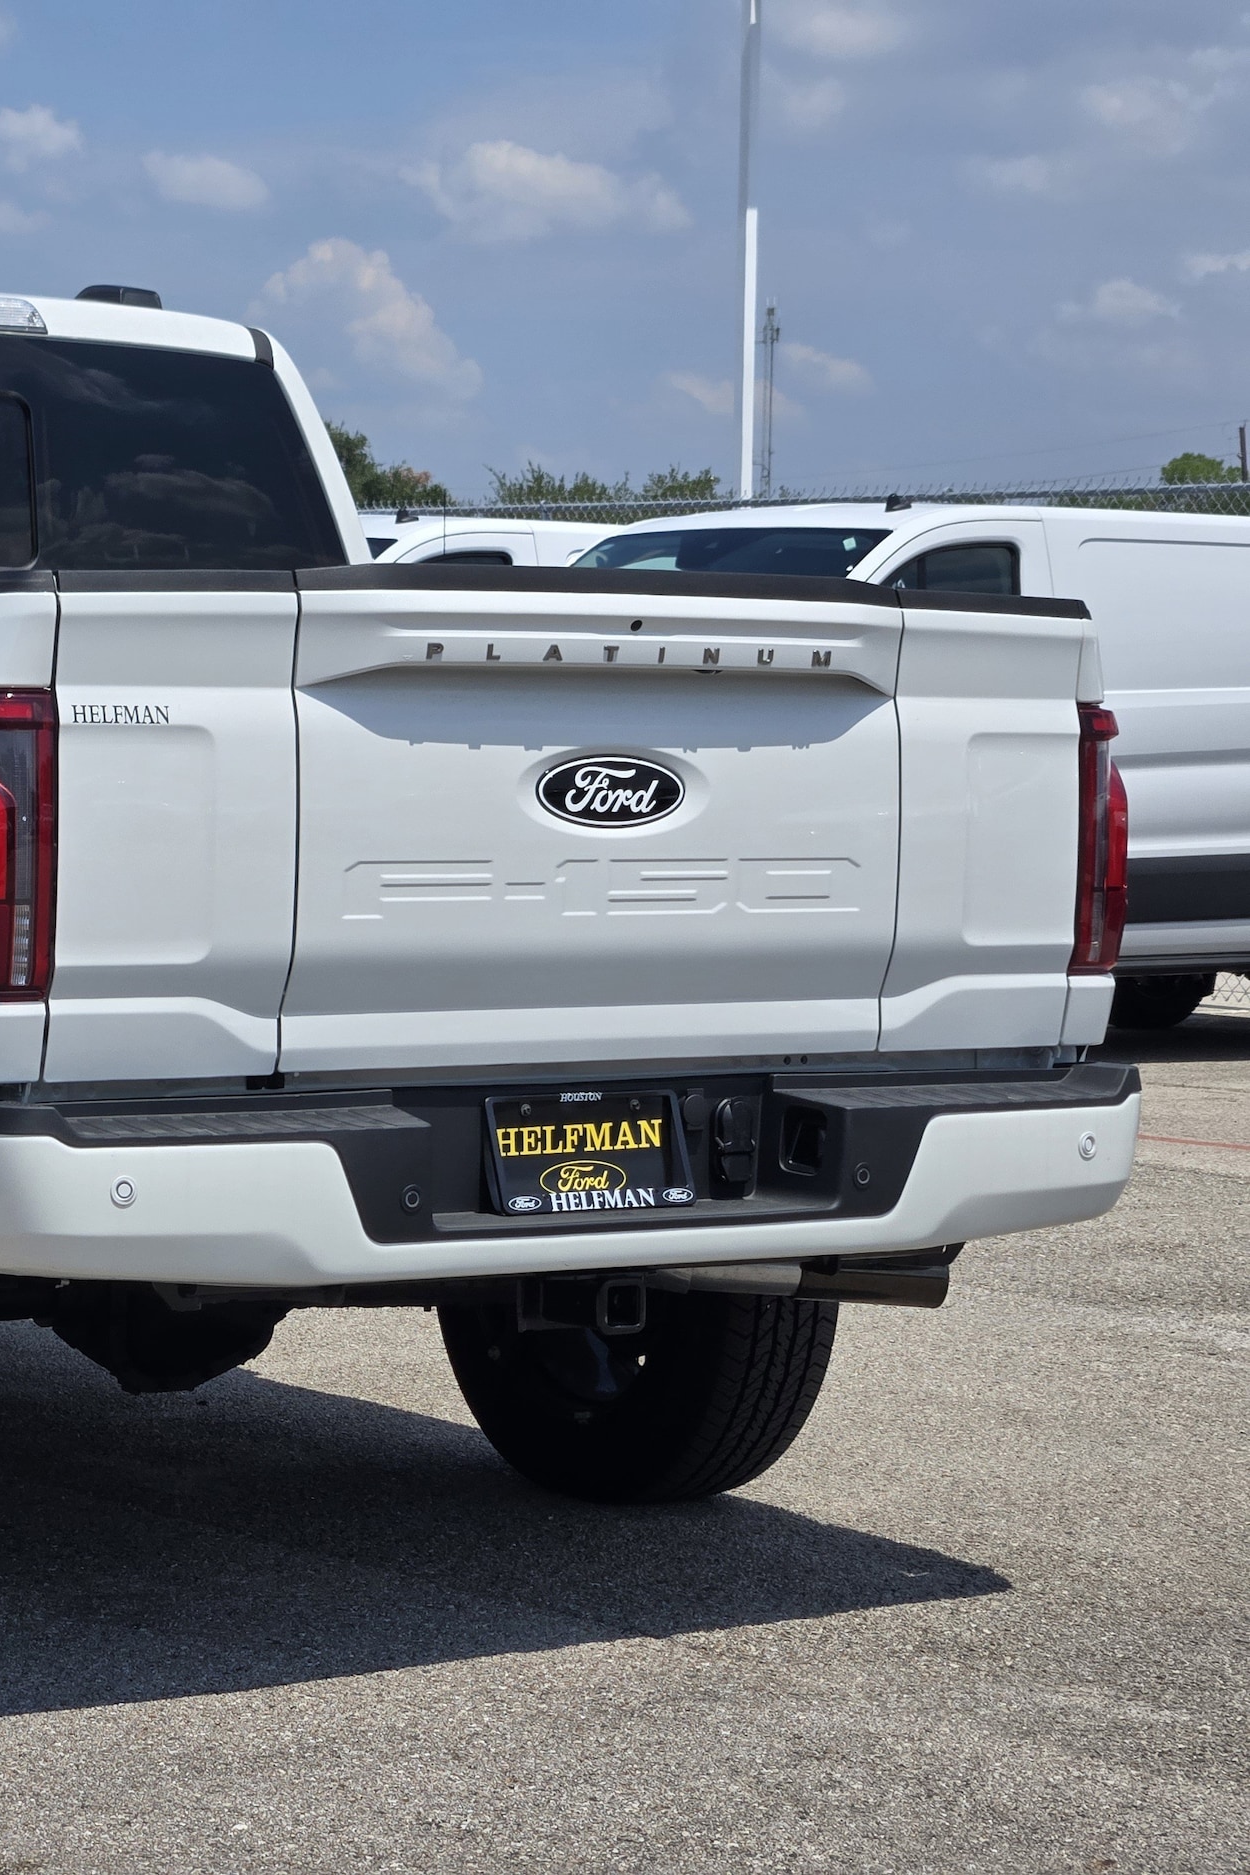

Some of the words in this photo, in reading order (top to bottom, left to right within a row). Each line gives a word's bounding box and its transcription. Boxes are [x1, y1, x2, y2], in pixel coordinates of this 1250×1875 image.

[425, 642, 832, 667] PLATINUM
[72, 703, 170, 726] HELFMAN
[565, 764, 660, 813] Ford
[342, 857, 862, 919] F-150
[559, 1091, 603, 1103] HOUSTON
[496, 1118, 663, 1157] HELFMAN
[557, 1164, 610, 1191] Ford
[549, 1188, 657, 1212] HELFMAN
